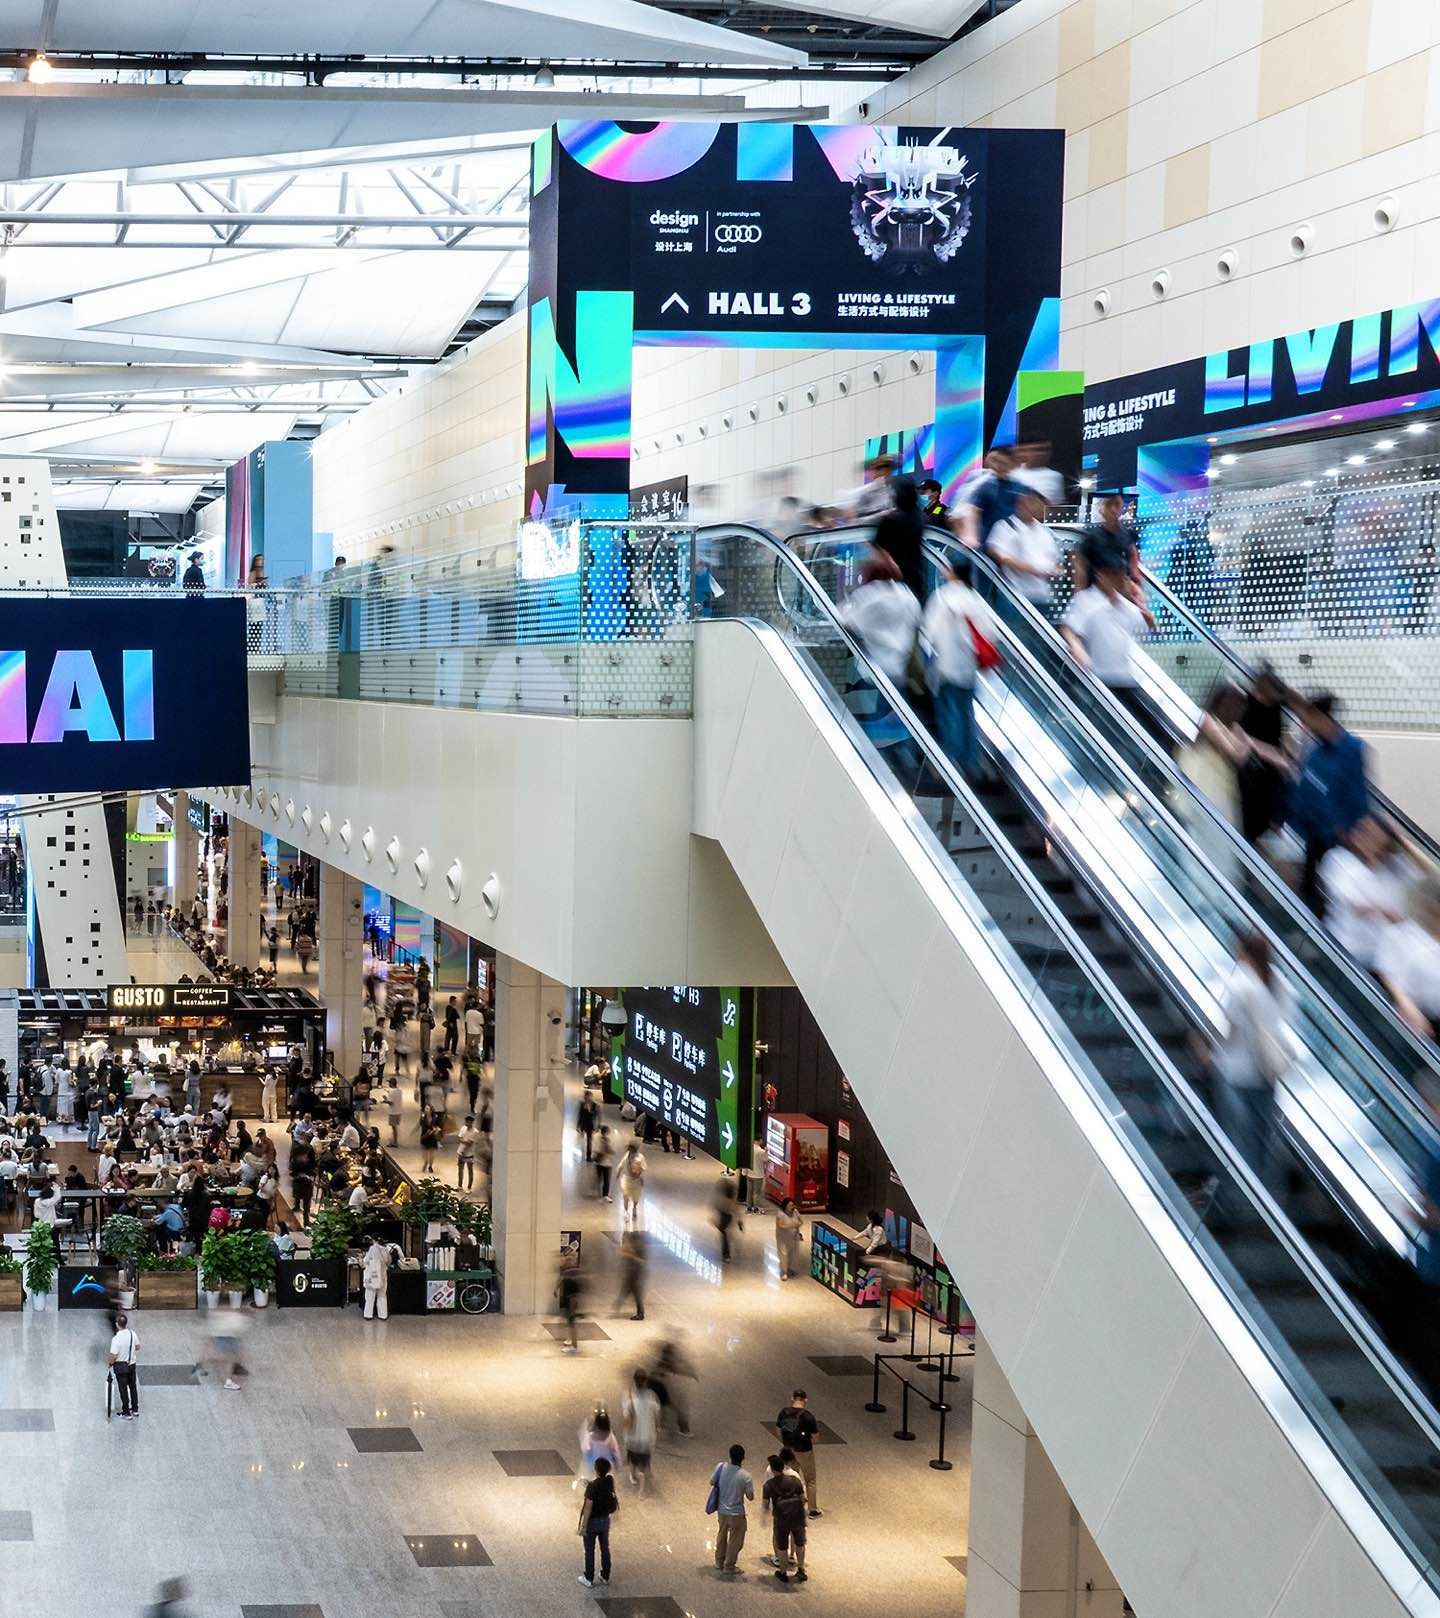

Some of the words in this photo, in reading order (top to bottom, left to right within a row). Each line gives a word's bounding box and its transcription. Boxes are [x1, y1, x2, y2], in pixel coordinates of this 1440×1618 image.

[649, 210, 699, 228] design
[655, 241, 693, 252] 设计上海
[708, 292, 785, 315] HALL
[791, 292, 812, 315] 3
[838, 293, 881, 304] LIVING
[885, 294, 894, 304] &
[896, 294, 956, 305] LIFESTYLE
[837, 305, 930, 318] 生活方式与配饰设计
[1083, 404, 1106, 424] ING
[1118, 388, 1176, 416] LIFESTYLE
[113, 987, 165, 1007] GUSTO
